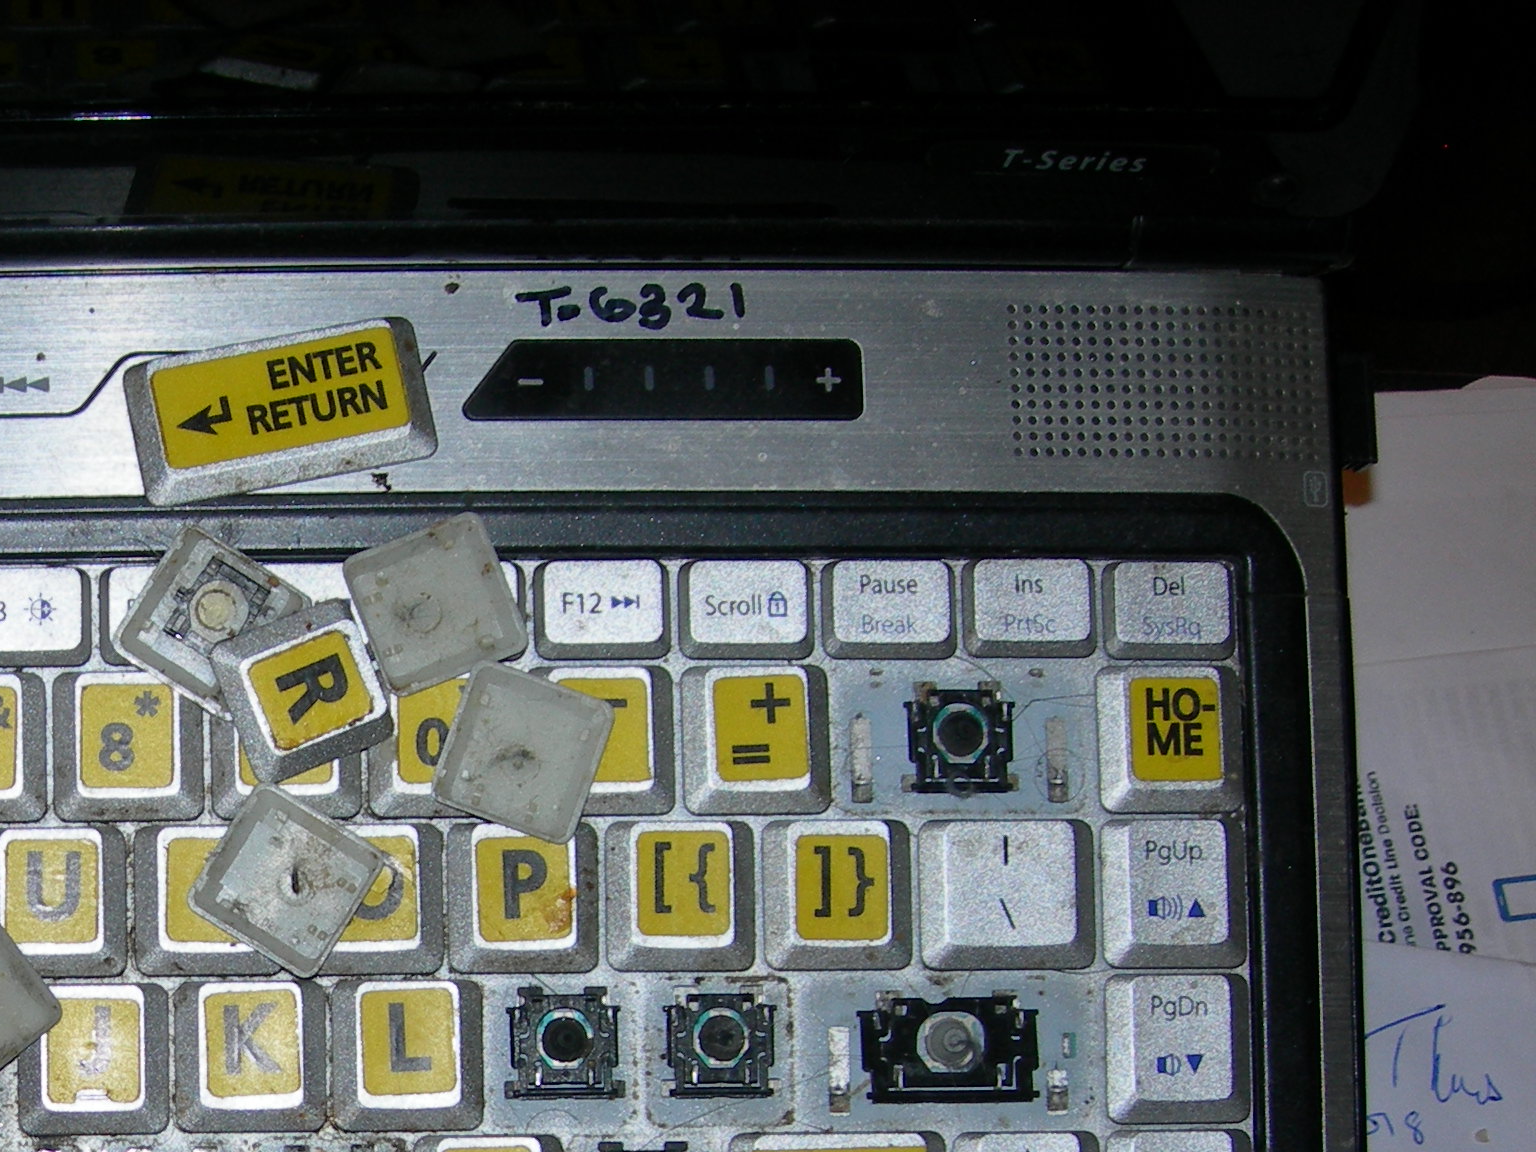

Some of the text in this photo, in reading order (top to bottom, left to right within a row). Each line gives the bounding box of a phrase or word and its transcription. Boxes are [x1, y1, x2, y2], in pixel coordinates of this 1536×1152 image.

[1001, 147, 1148, 173] T-Series
[267, 341, 384, 391] ENTER
[245, 382, 389, 437] RETURN
[561, 592, 602, 614] F12
[859, 575, 920, 598] Pause
[1013, 575, 1044, 596] Ins
[1152, 575, 1186, 597] Del
[704, 595, 763, 618] Scroll
[861, 613, 918, 636] Break
[275, 652, 348, 726] R
[1146, 722, 1204, 758] ME
[1144, 839, 1205, 866] PgUp
[25, 851, 82, 922] U
[503, 849, 549, 920] P
[1404, 803, 1452, 952] PPROVAL CODE:
[1148, 995, 1209, 1022] PgDn
[74, 1005, 114, 1079] J
[223, 1003, 284, 1076] K
[388, 1002, 433, 1072] L
